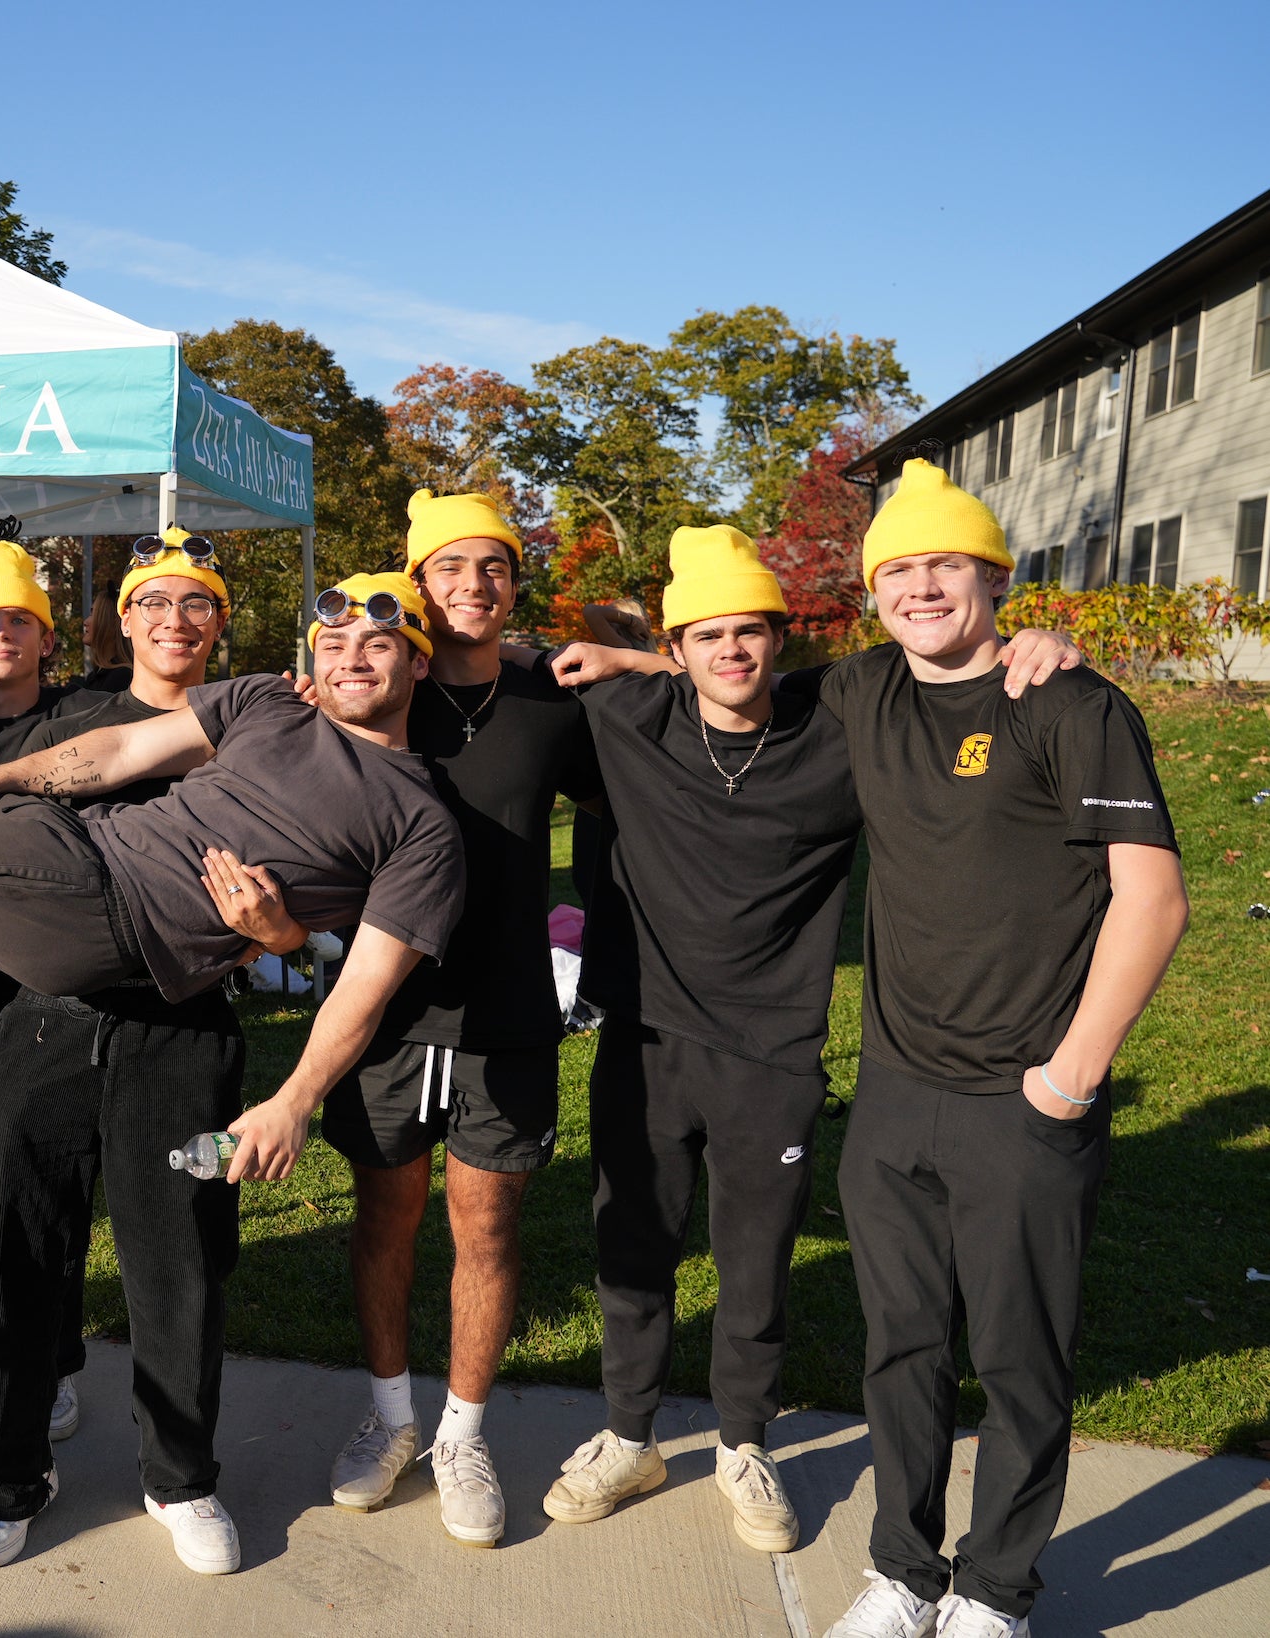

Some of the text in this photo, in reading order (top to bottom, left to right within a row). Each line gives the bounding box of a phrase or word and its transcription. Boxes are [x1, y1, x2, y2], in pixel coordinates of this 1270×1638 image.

[190, 382, 234, 483] ZETA
[234, 416, 263, 496] TAU
[266, 437, 308, 511] ALPHA
[1081, 797, 1154, 810] goarmy.com/rotc
